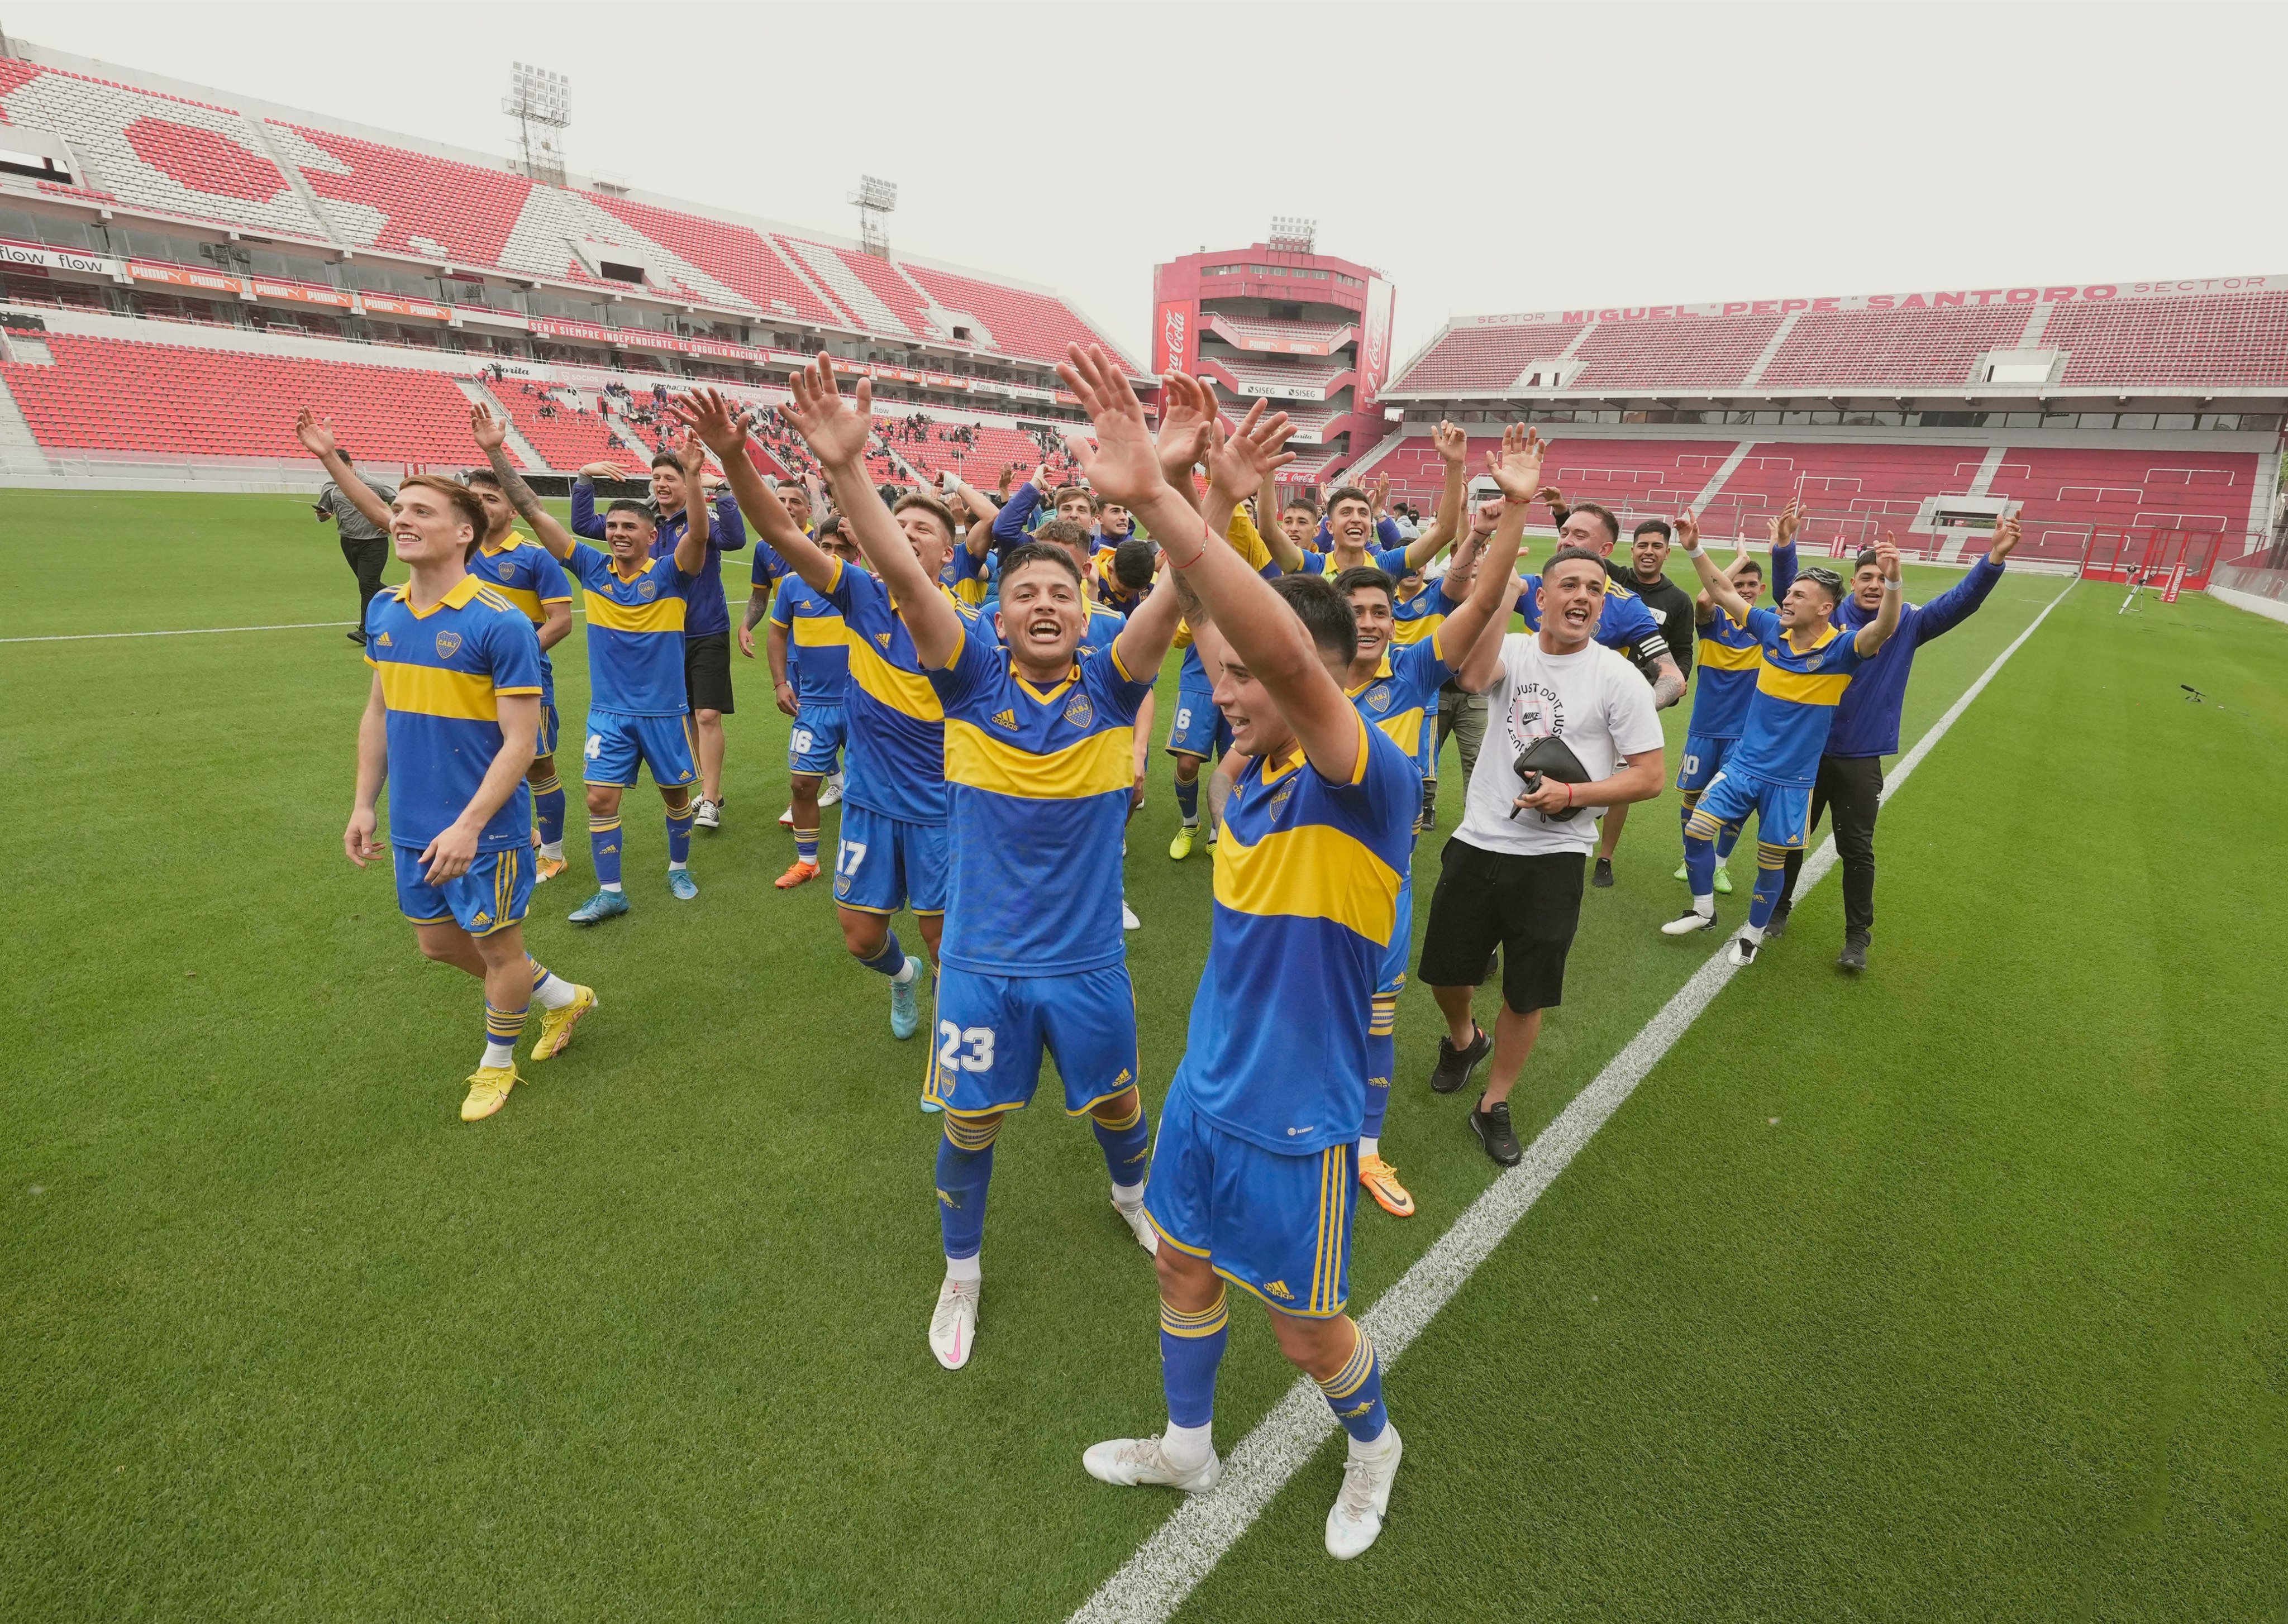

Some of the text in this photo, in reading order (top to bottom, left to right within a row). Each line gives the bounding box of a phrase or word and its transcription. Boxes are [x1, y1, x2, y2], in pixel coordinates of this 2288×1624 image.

[58, 254, 102, 272] flow
[131, 266, 225, 289] PUMA PUMA
[2133, 276, 2266, 293] SECTOR
[255, 284, 338, 304] PUMA PUMA
[364, 298, 437, 317] PUMA PUMA
[1477, 313, 1546, 323] SECTOR
[1562, 305, 1699, 323] MIGUEL
[1866, 285, 2118, 309] SANTORO
[531, 322, 768, 362] SERÁ SIEMPRE INDEPENDIENTE, EL ORGULLO NACIONAL
[1249, 340, 1312, 352] PUMA PUMA
[848, 365, 864, 374] PUMA
[995, 385, 1008, 394] flow
[1295, 389, 1315, 398] SISEG
[1369, 693, 1387, 703] CABJ
[1517, 683, 1539, 696] JUST
[1539, 688, 1556, 701] DO
[1066, 704, 1089, 717] CABJ
[1176, 708, 1192, 729] 6
[992, 716, 1018, 731] adidas
[790, 728, 813, 754] 16
[837, 838, 866, 876] 17
[940, 1019, 995, 1072] 23
[1112, 1074, 1132, 1086] adidas
[1264, 1284, 1295, 1300] adidas
